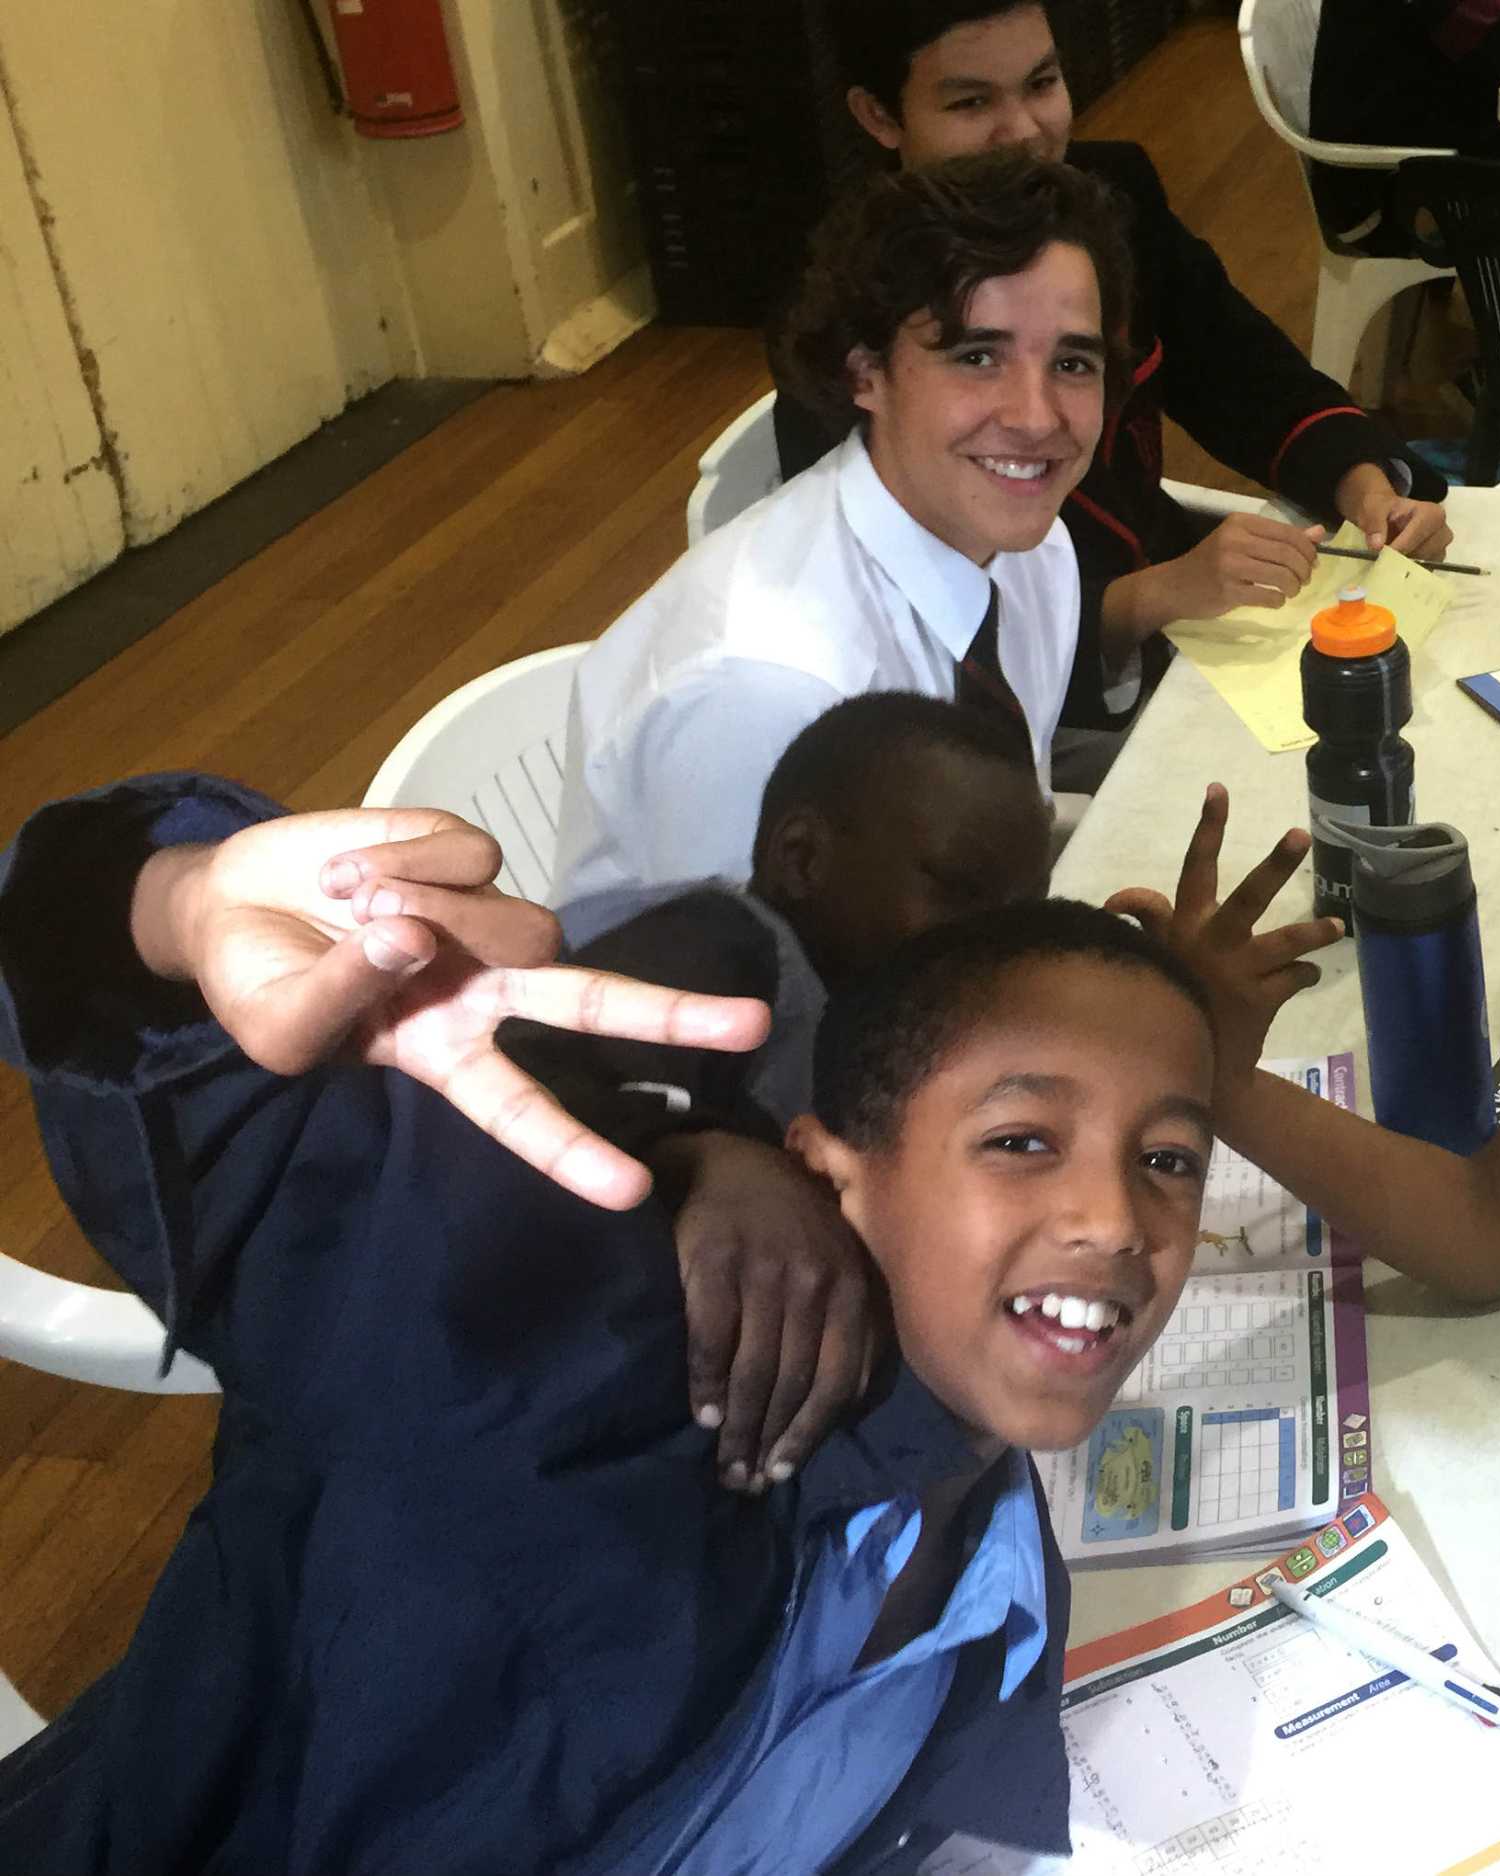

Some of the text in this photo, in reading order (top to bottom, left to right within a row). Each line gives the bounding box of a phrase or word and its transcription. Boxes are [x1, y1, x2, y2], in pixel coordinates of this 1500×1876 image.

[1211, 1619, 1259, 1646] Number
[1281, 1692, 1361, 1736] Measurement
[1367, 1676, 1392, 1695] Area
